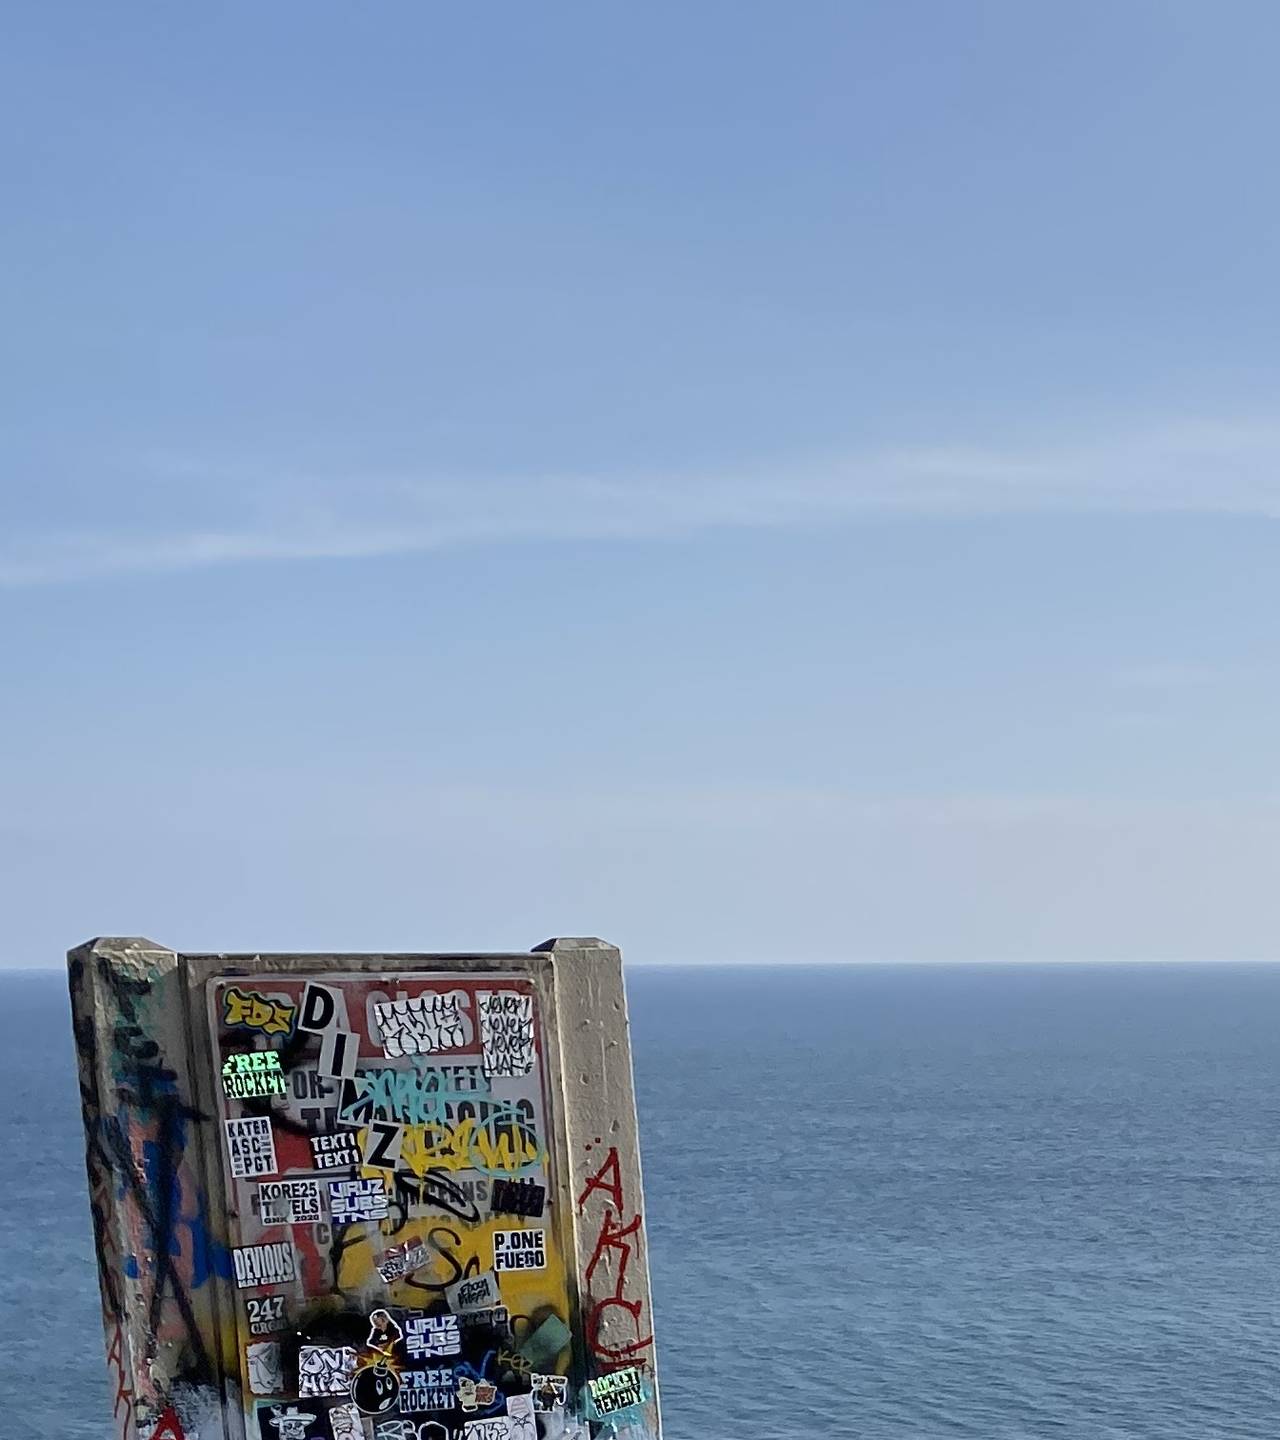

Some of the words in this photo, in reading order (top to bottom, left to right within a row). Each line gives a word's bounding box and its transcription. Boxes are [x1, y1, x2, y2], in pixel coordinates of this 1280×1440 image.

[223, 1051, 280, 1074] FREE
[223, 1071, 284, 1098] ROCKET
[228, 1120, 269, 1137] KATER
[232, 1138, 260, 1156] ASC
[244, 1155, 273, 1174] PGT
[261, 1182, 317, 1200] KORE25
[495, 1231, 543, 1250] P.ONE
[233, 1243, 294, 1279] DEVIOUS
[496, 1250, 545, 1269] FUEGO
[247, 1297, 284, 1323] 247
[400, 1369, 452, 1388] FREE
[588, 1367, 639, 1398] ROCKET
[401, 1387, 455, 1411] ROCKET
[594, 1384, 641, 1415] REMEDY
